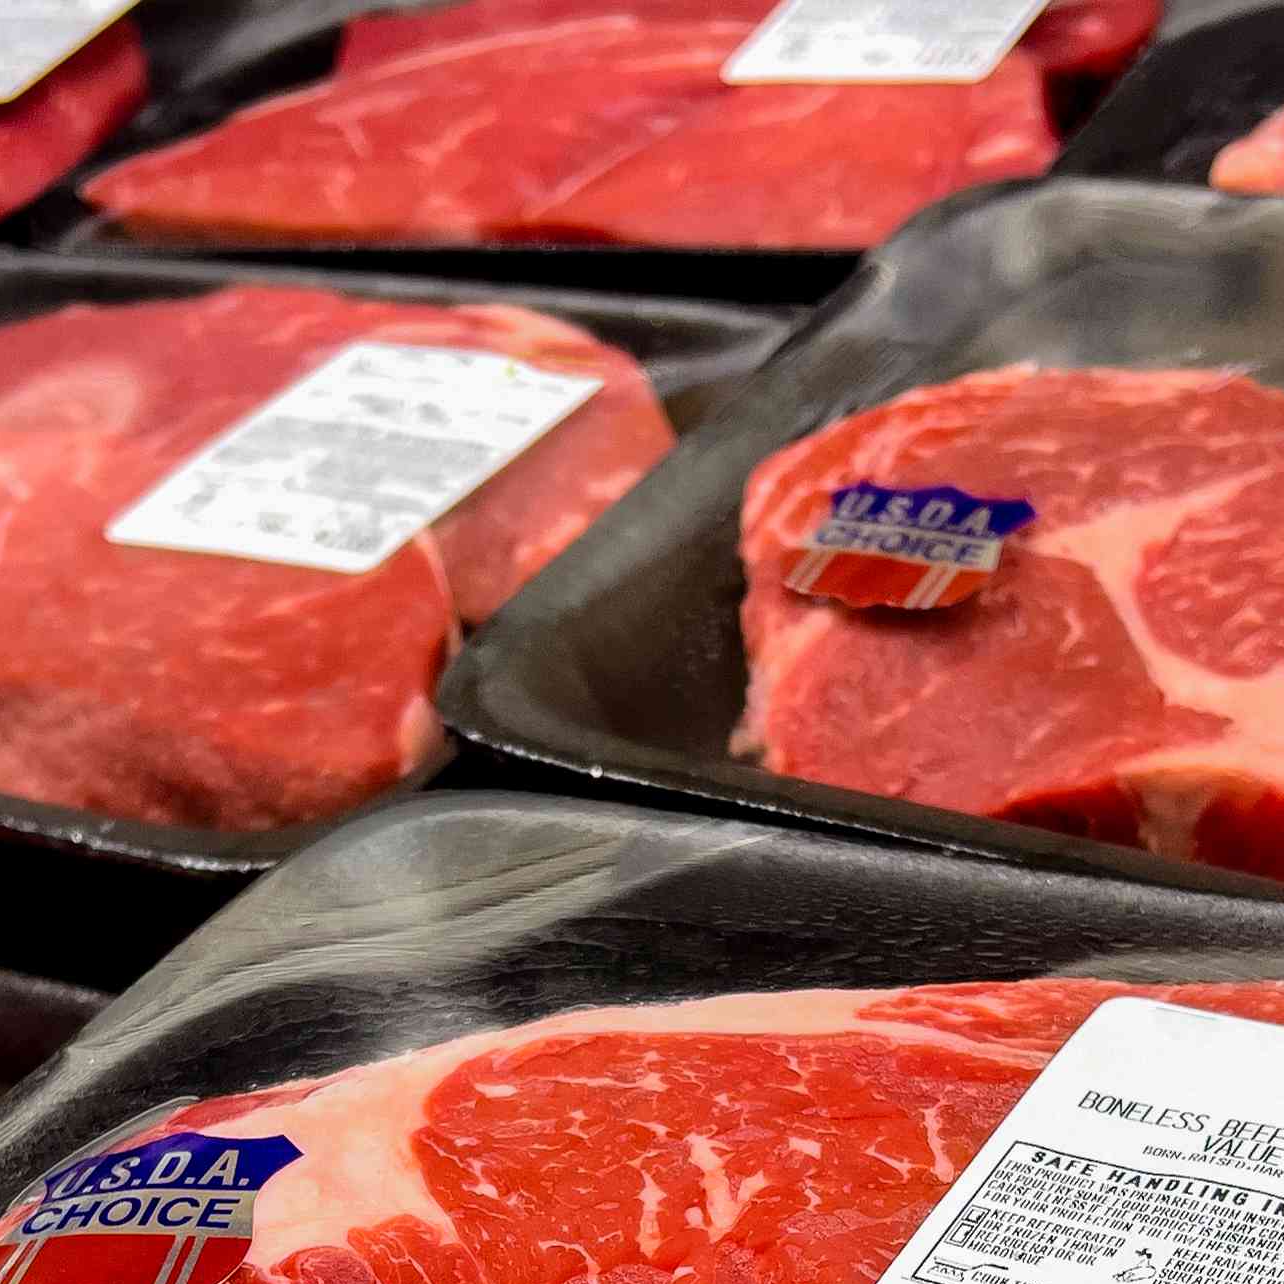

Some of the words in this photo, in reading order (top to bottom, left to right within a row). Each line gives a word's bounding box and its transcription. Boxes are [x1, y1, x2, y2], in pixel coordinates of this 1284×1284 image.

[1077, 1090, 1209, 1132] BONELESS
[53, 1148, 250, 1199] U.S.D.A.
[1031, 1151, 1097, 1176] SAFE
[1106, 1169, 1248, 1205] HANDLING
[21, 1196, 241, 1235] CHOICE
